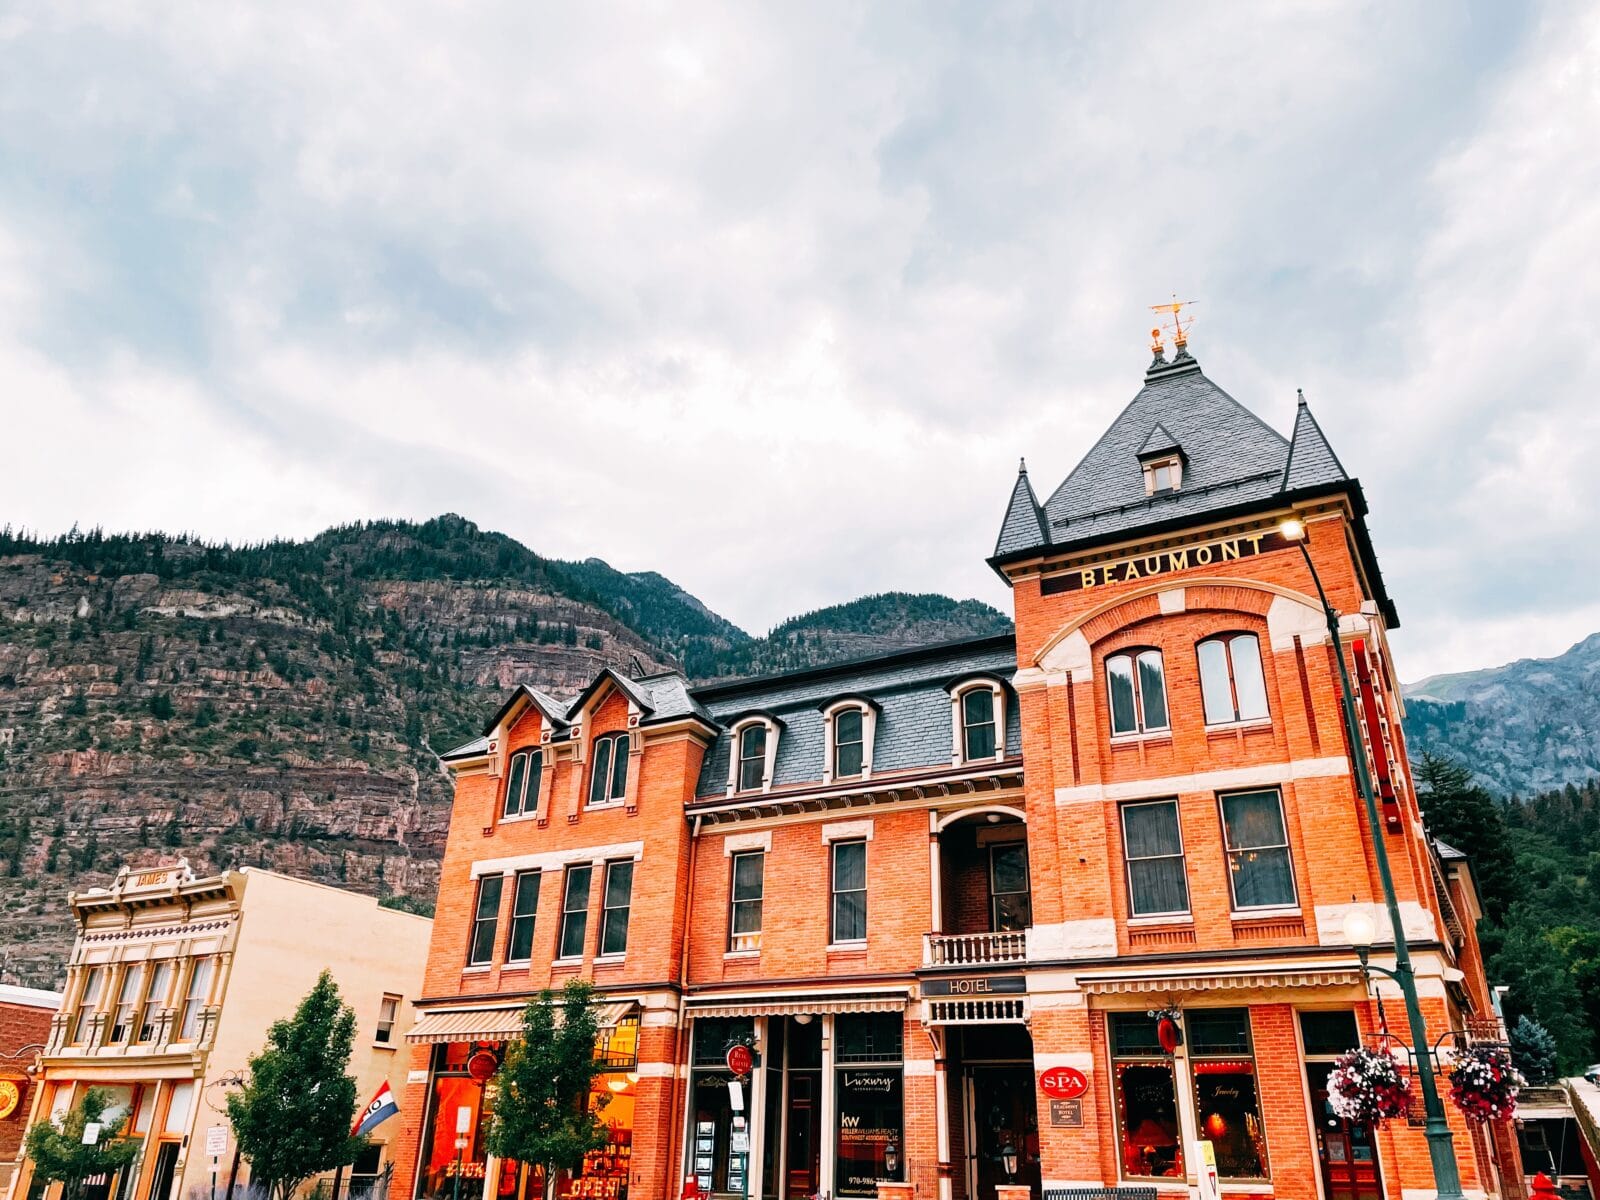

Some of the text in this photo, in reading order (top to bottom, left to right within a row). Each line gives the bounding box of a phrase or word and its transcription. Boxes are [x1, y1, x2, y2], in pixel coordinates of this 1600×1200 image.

[1080, 534, 1264, 589] BEAUMONT
[136, 871, 168, 887] JAMES
[950, 979, 993, 993] HOTEL
[844, 1072, 895, 1092] Luxury
[1044, 1076, 1083, 1088] SPA
[841, 1111, 860, 1127] kw
[571, 1178, 617, 1197] OPEN
